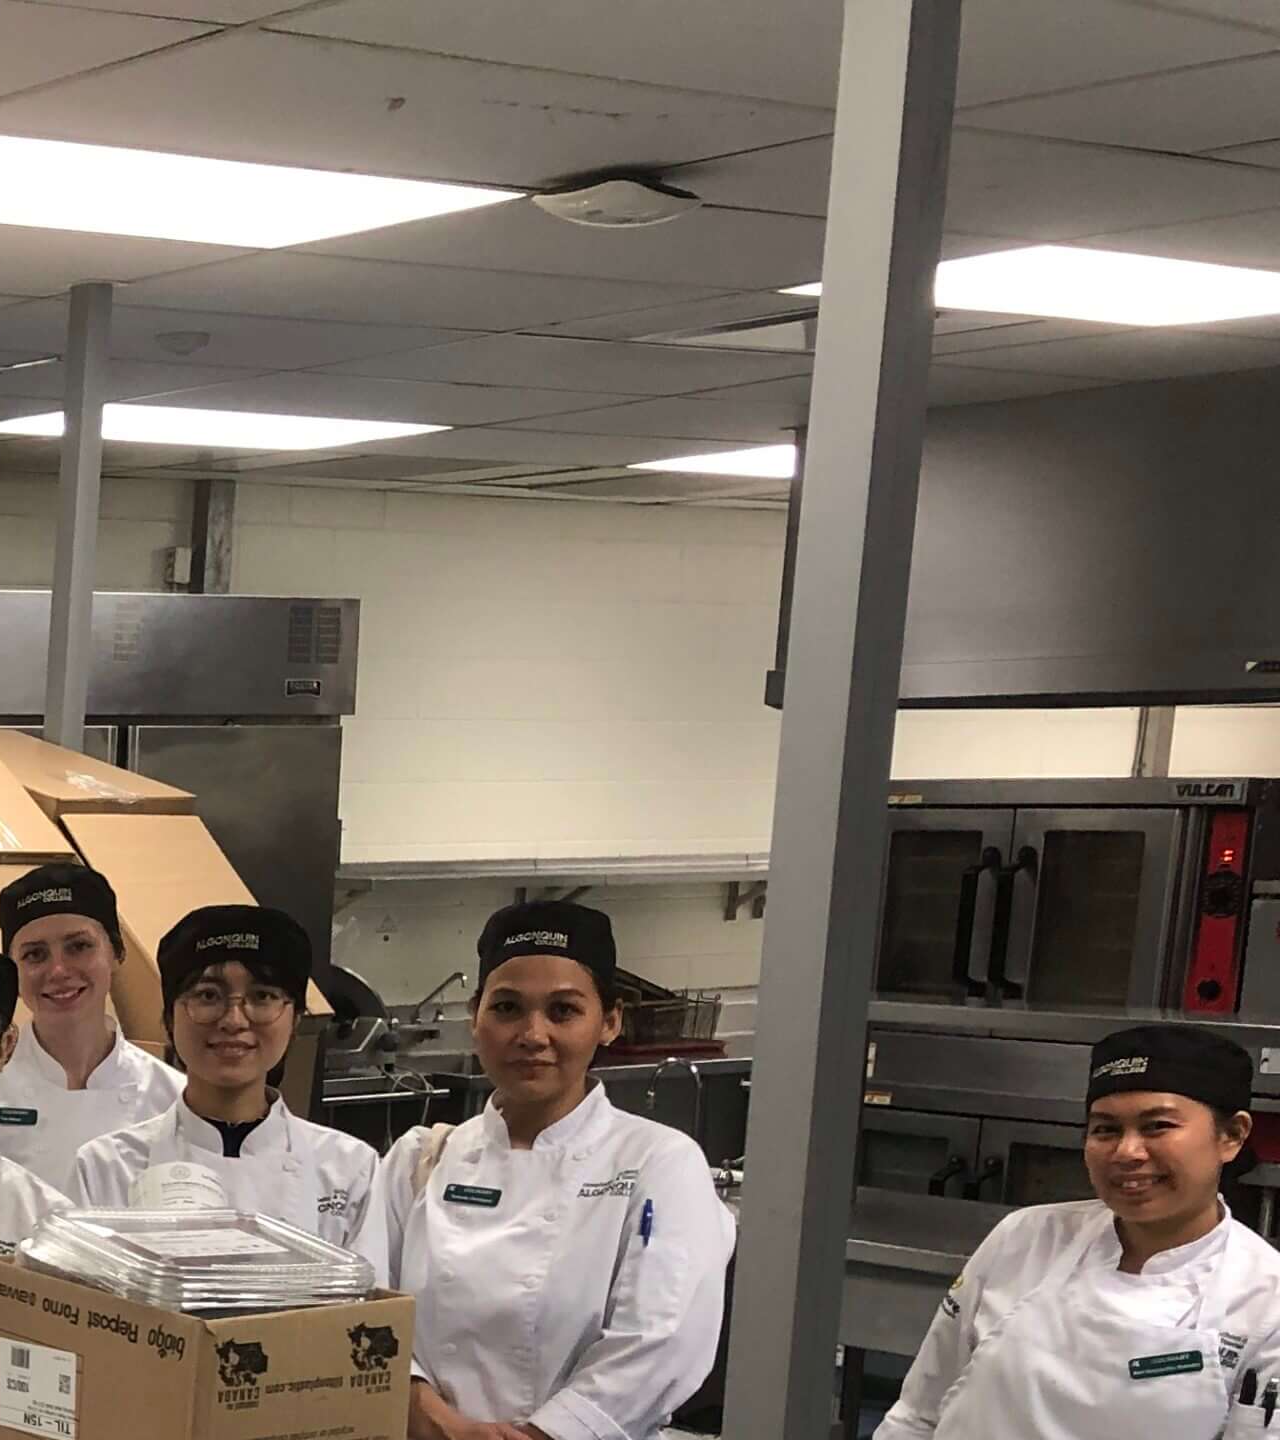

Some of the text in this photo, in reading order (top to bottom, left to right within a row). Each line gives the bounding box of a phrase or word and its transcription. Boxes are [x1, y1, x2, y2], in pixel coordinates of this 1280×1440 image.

[1176, 784, 1234, 797] VULCAN
[42, 1297, 80, 1325] Forno
[87, 1310, 139, 1343] Repost
[350, 1371, 391, 1388] CANADA
[217, 1386, 260, 1404] CANADA
[23, 1412, 43, 1427] 15N
[54, 1419, 72, 1435] TIL
